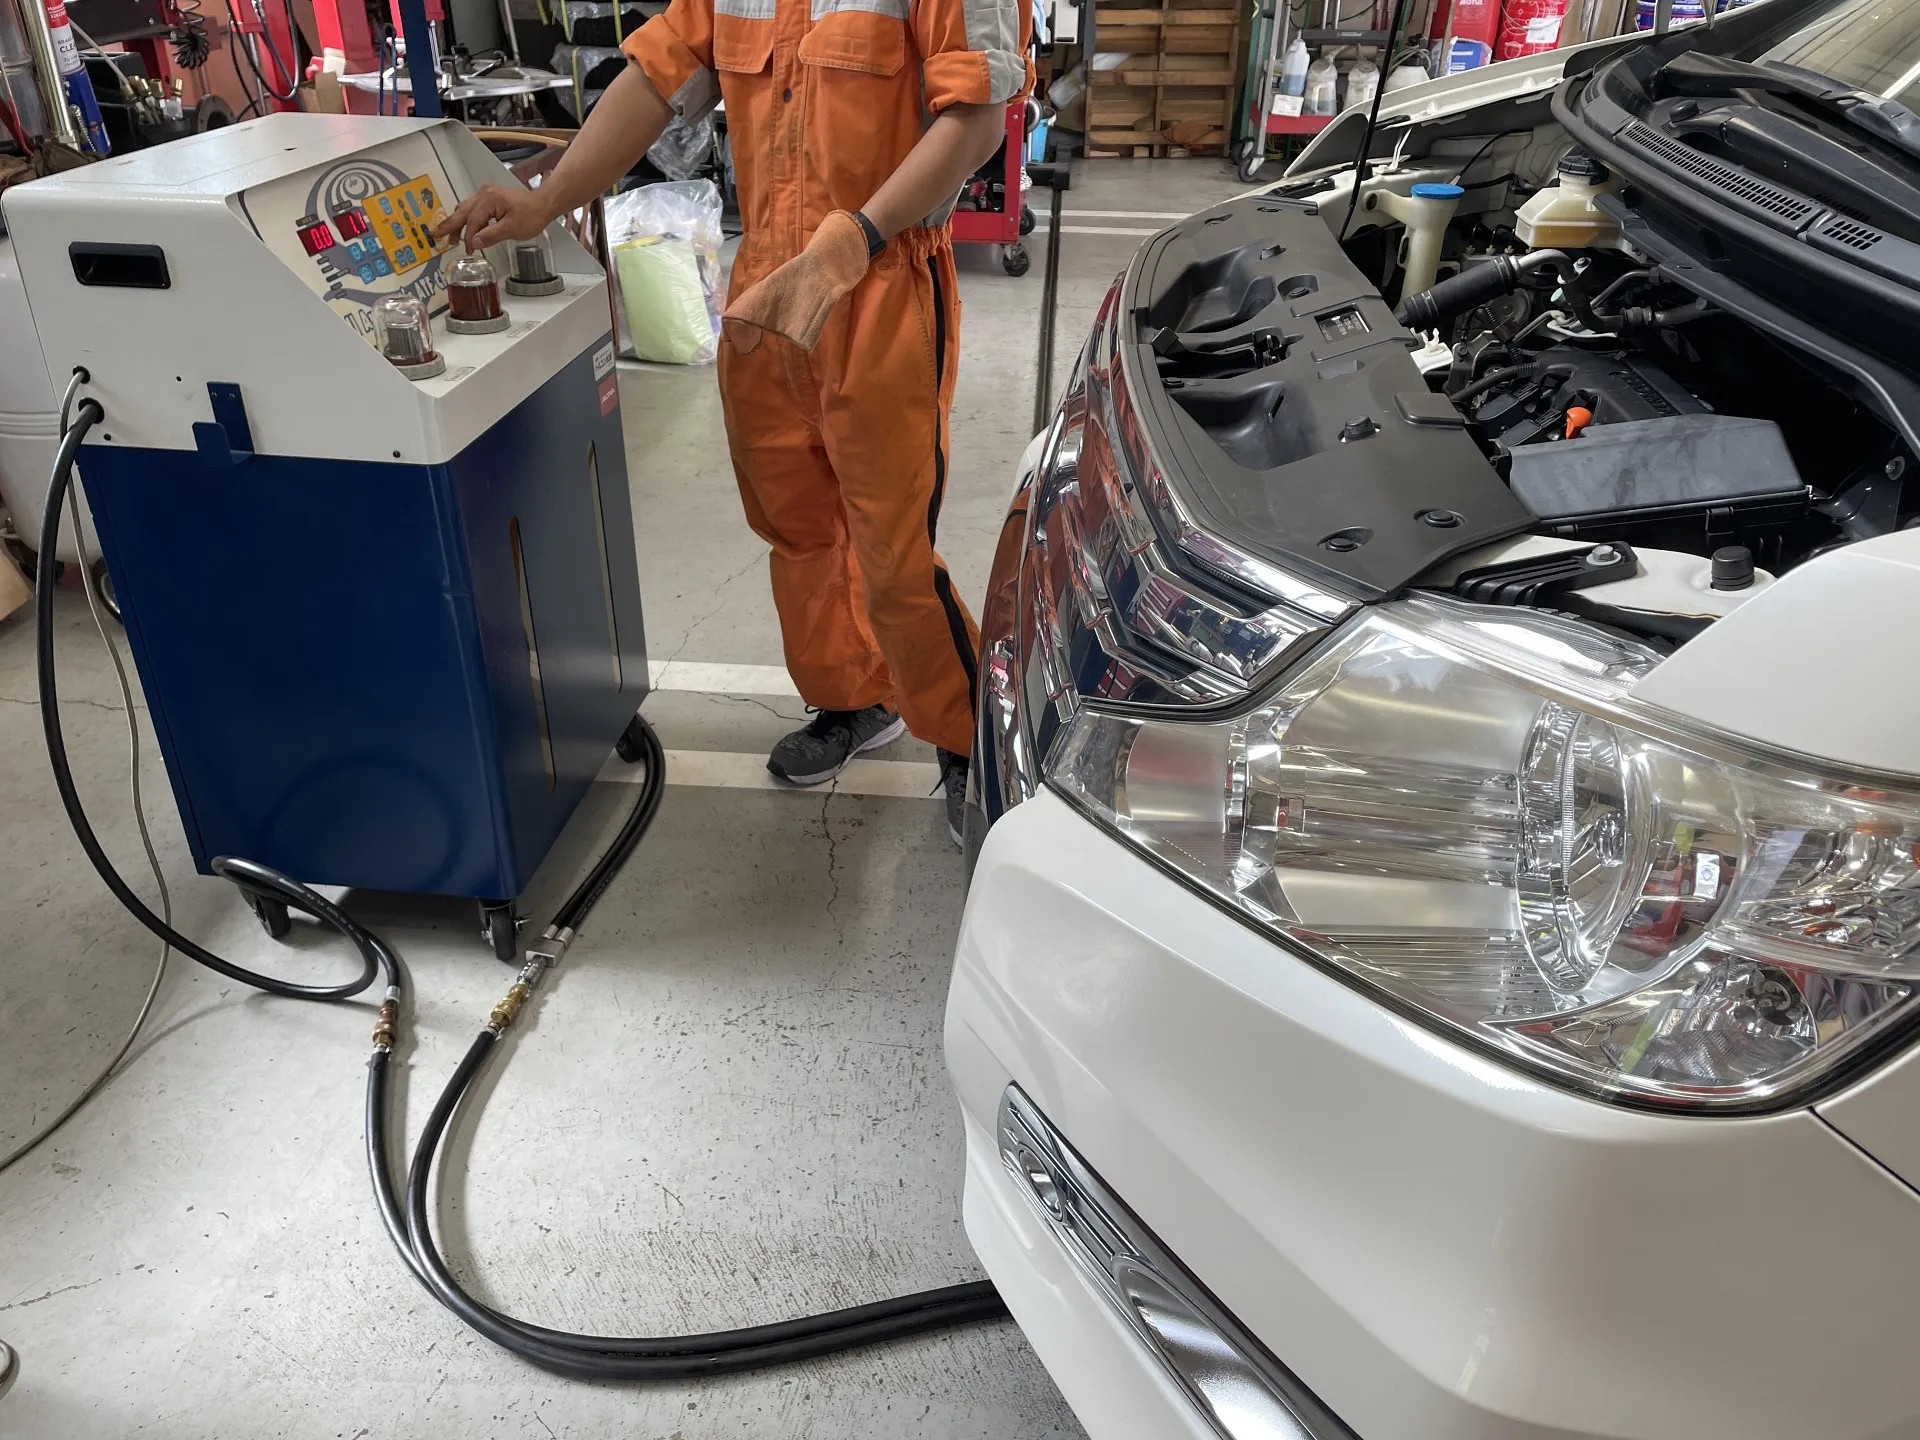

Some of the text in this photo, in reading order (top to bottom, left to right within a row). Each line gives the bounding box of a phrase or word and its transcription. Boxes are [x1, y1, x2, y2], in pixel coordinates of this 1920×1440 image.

[60, 42, 75, 53] CLE
[349, 211, 367, 235] 1.1
[310, 224, 334, 250] 0.0
